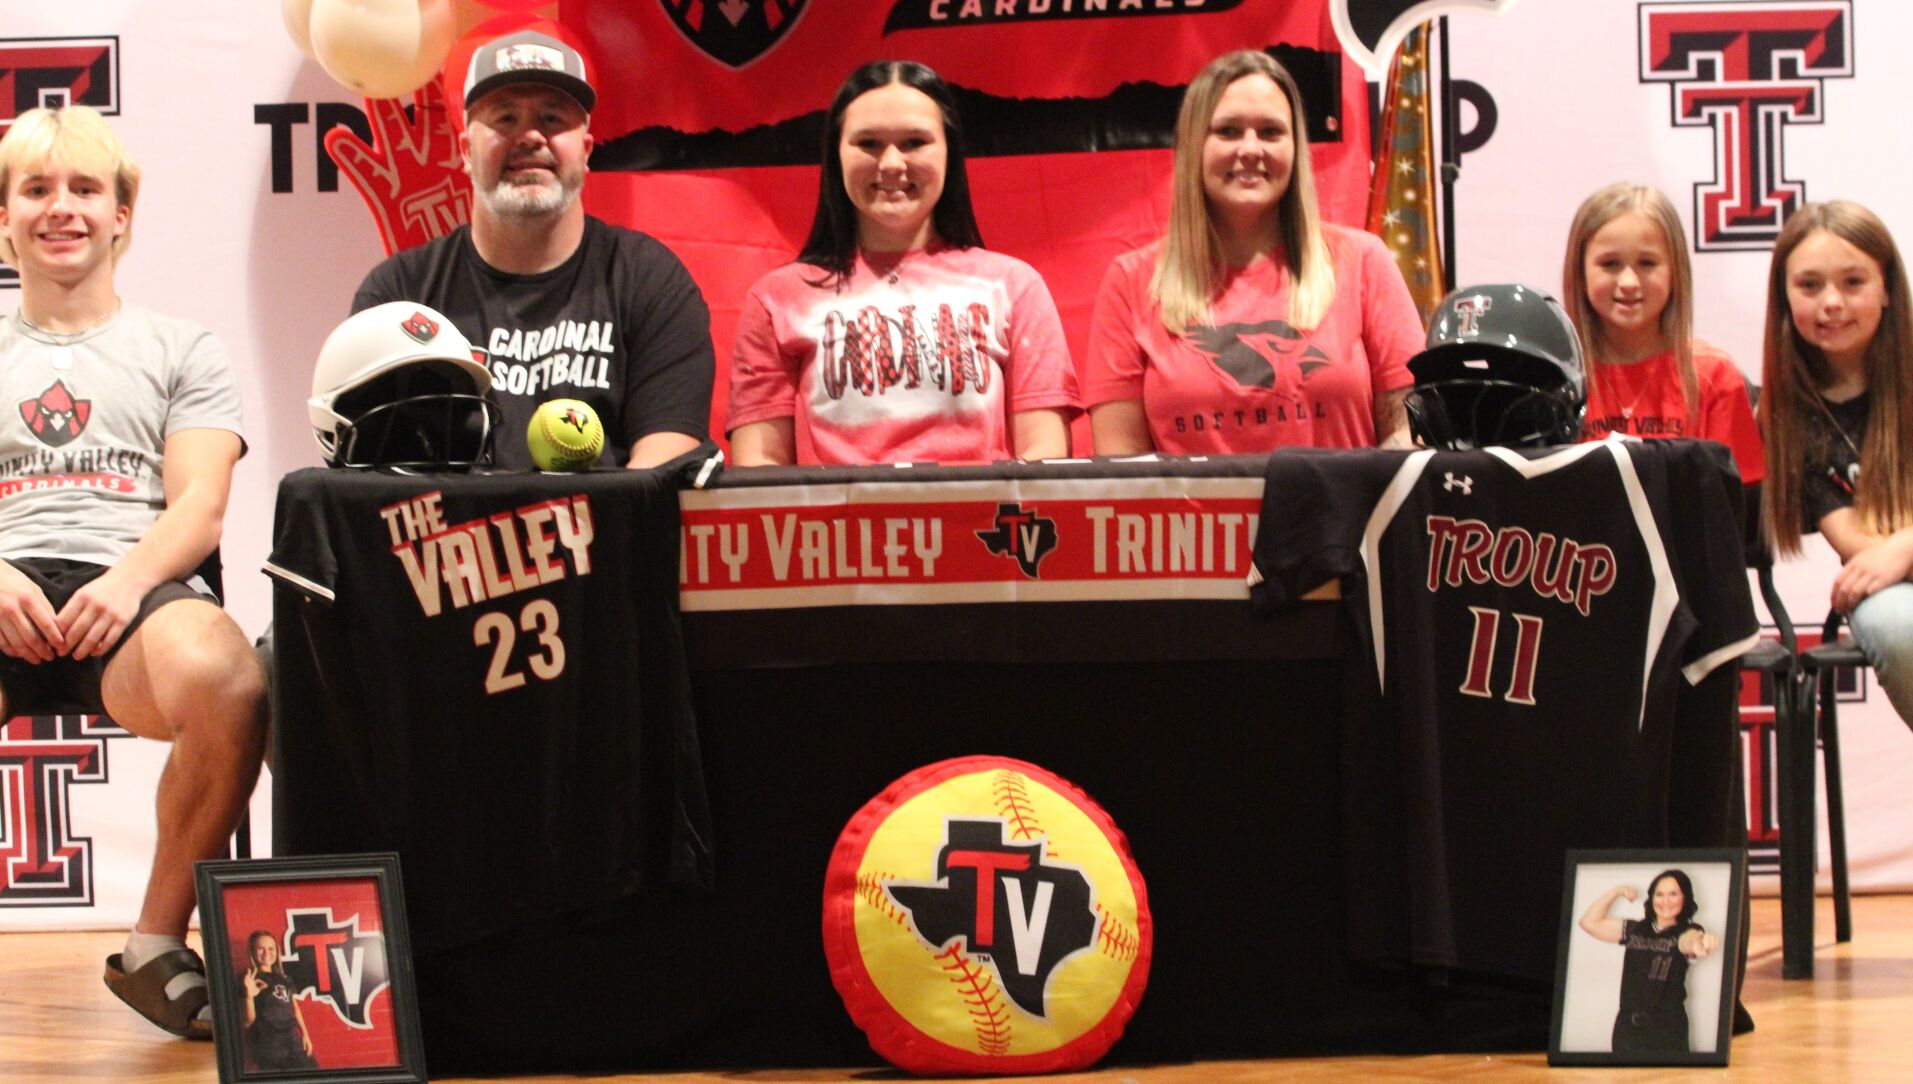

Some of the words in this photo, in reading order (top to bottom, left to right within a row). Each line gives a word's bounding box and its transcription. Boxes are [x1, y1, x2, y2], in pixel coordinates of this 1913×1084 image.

[488, 319, 615, 362] CARDINAL
[491, 352, 610, 396] SOFTBALL
[1174, 402, 1326, 433] SOFTBALL
[62, 447, 145, 478] VALLEY
[379, 490, 447, 546] THE
[760, 513, 943, 581] VALLEY
[390, 494, 595, 618] VALLEY
[1426, 514, 1617, 618] TROUP
[473, 598, 566, 695] 23
[1459, 605, 1543, 706] 11
[946, 850, 1055, 977] TV
[295, 931, 365, 1005] TV
